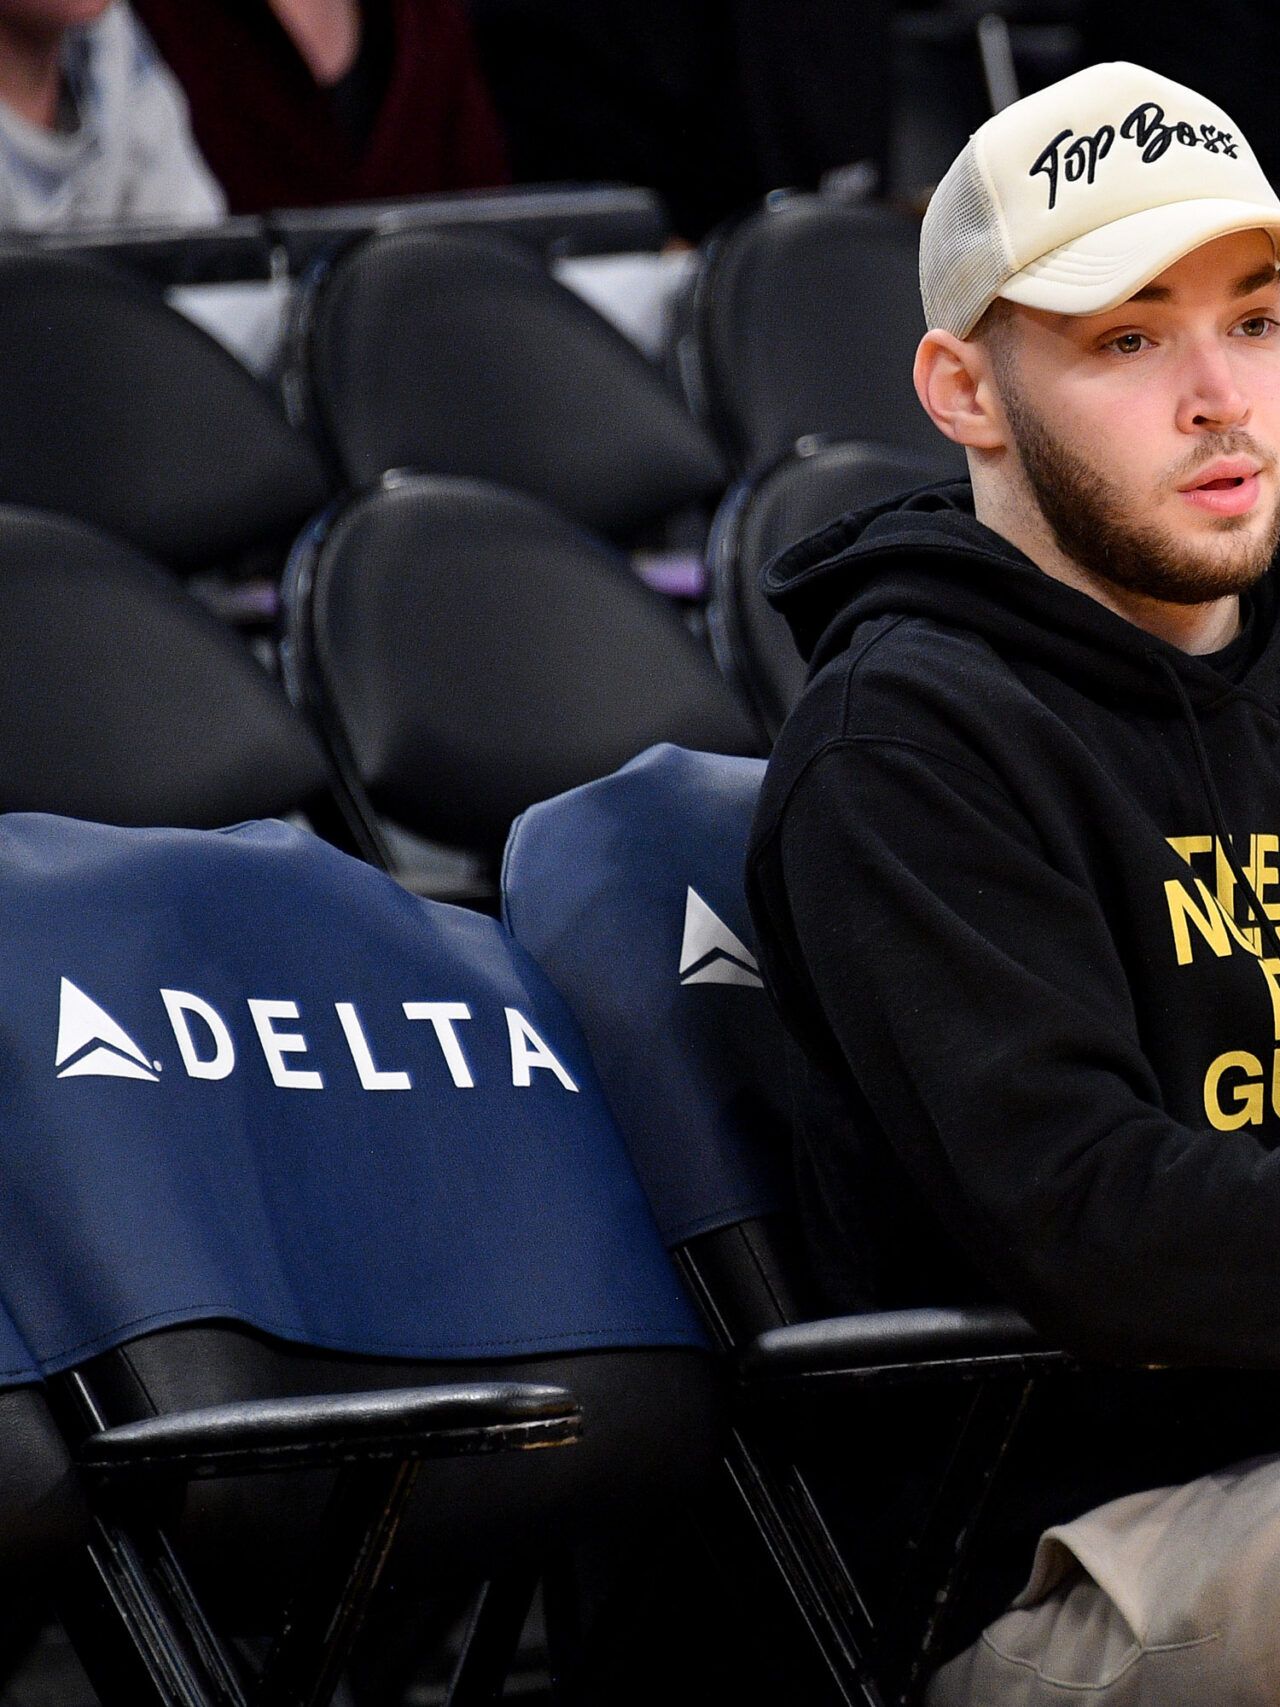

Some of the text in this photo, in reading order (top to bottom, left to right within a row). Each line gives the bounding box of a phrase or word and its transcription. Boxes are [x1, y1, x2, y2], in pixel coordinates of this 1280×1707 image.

[1029, 102, 1239, 210] Top Boss
[159, 988, 580, 1093] DELTA
